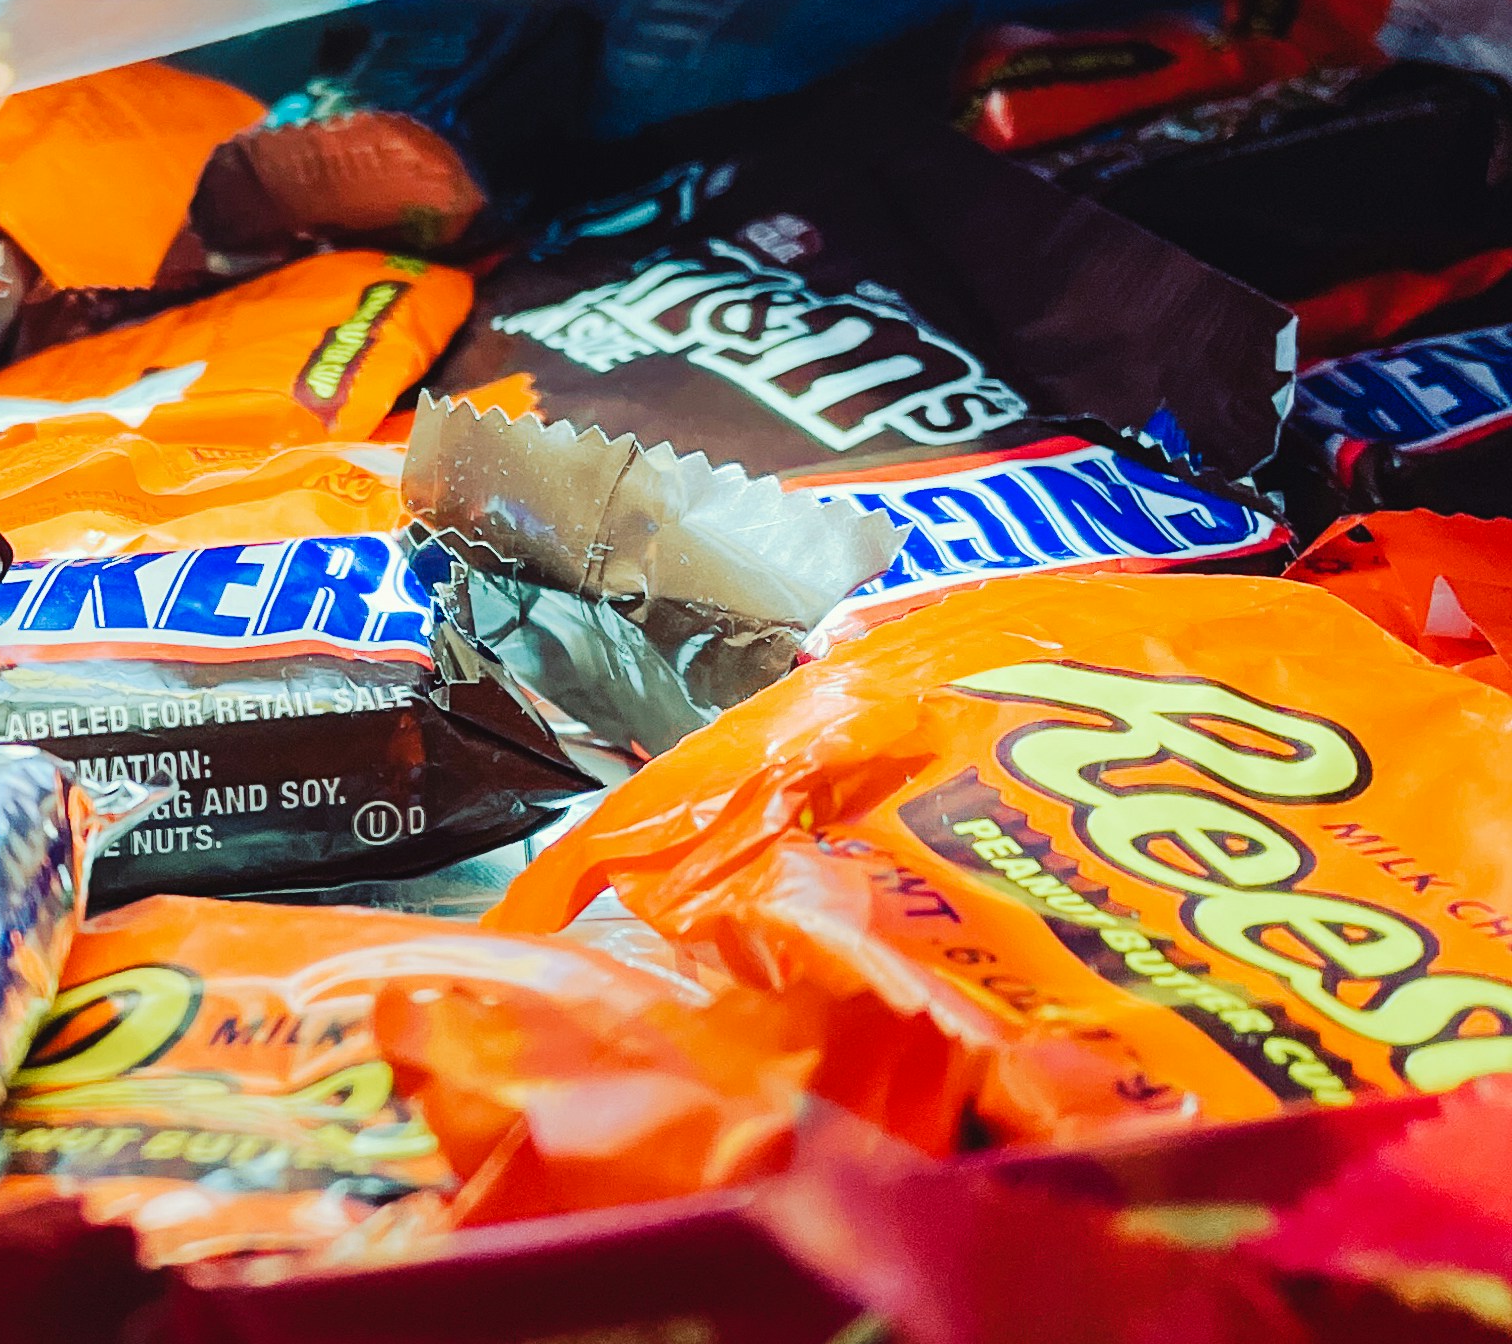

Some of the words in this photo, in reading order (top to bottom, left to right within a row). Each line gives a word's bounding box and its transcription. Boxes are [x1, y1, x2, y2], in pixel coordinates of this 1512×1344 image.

[142, 700, 205, 730] FOR
[213, 686, 322, 725] RETAIL
[333, 684, 413, 712] SALE
[201, 785, 273, 818] AND
[280, 777, 348, 808] SOY.
[132, 824, 223, 856] NUTS.
[1322, 821, 1448, 898] MILK
[952, 816, 1110, 942] PEANUT
